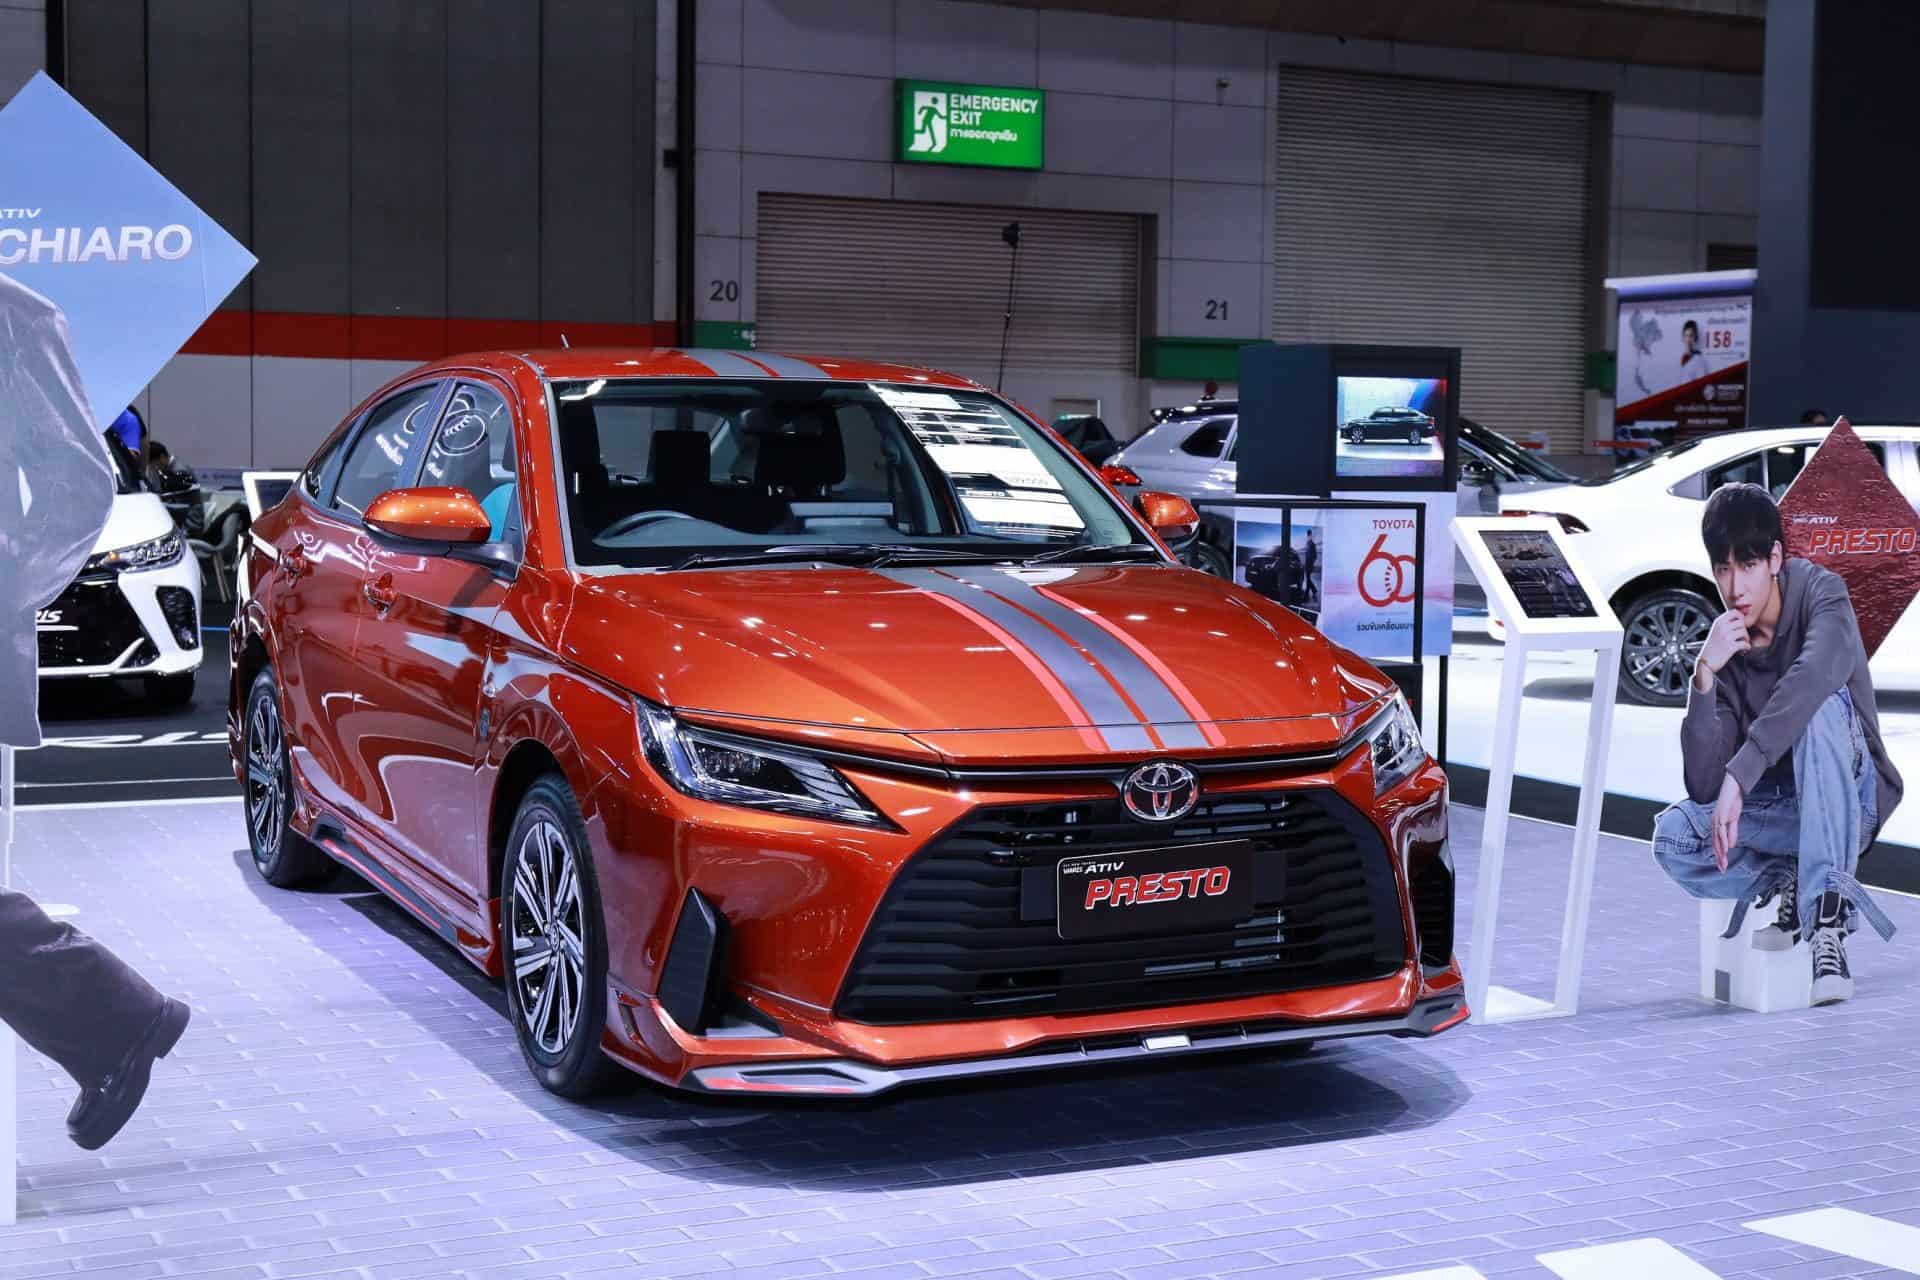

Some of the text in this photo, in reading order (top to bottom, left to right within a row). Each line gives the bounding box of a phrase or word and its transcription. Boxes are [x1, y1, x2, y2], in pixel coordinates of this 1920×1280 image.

[950, 93, 1038, 114] EMERGENCY
[950, 110, 982, 126] EXIT
[0, 208, 42, 218] TIV
[0, 224, 192, 264] CHIARO
[710, 280, 738, 302] 20
[1205, 300, 1228, 320] 21
[1704, 331, 1732, 348] 158
[1372, 519, 1415, 529] TOYOTA
[1808, 516, 1838, 524] ATIV
[1809, 527, 1917, 555] PRESTO
[1084, 861, 1125, 874] ATIV
[1084, 866, 1231, 910] PRESTO
